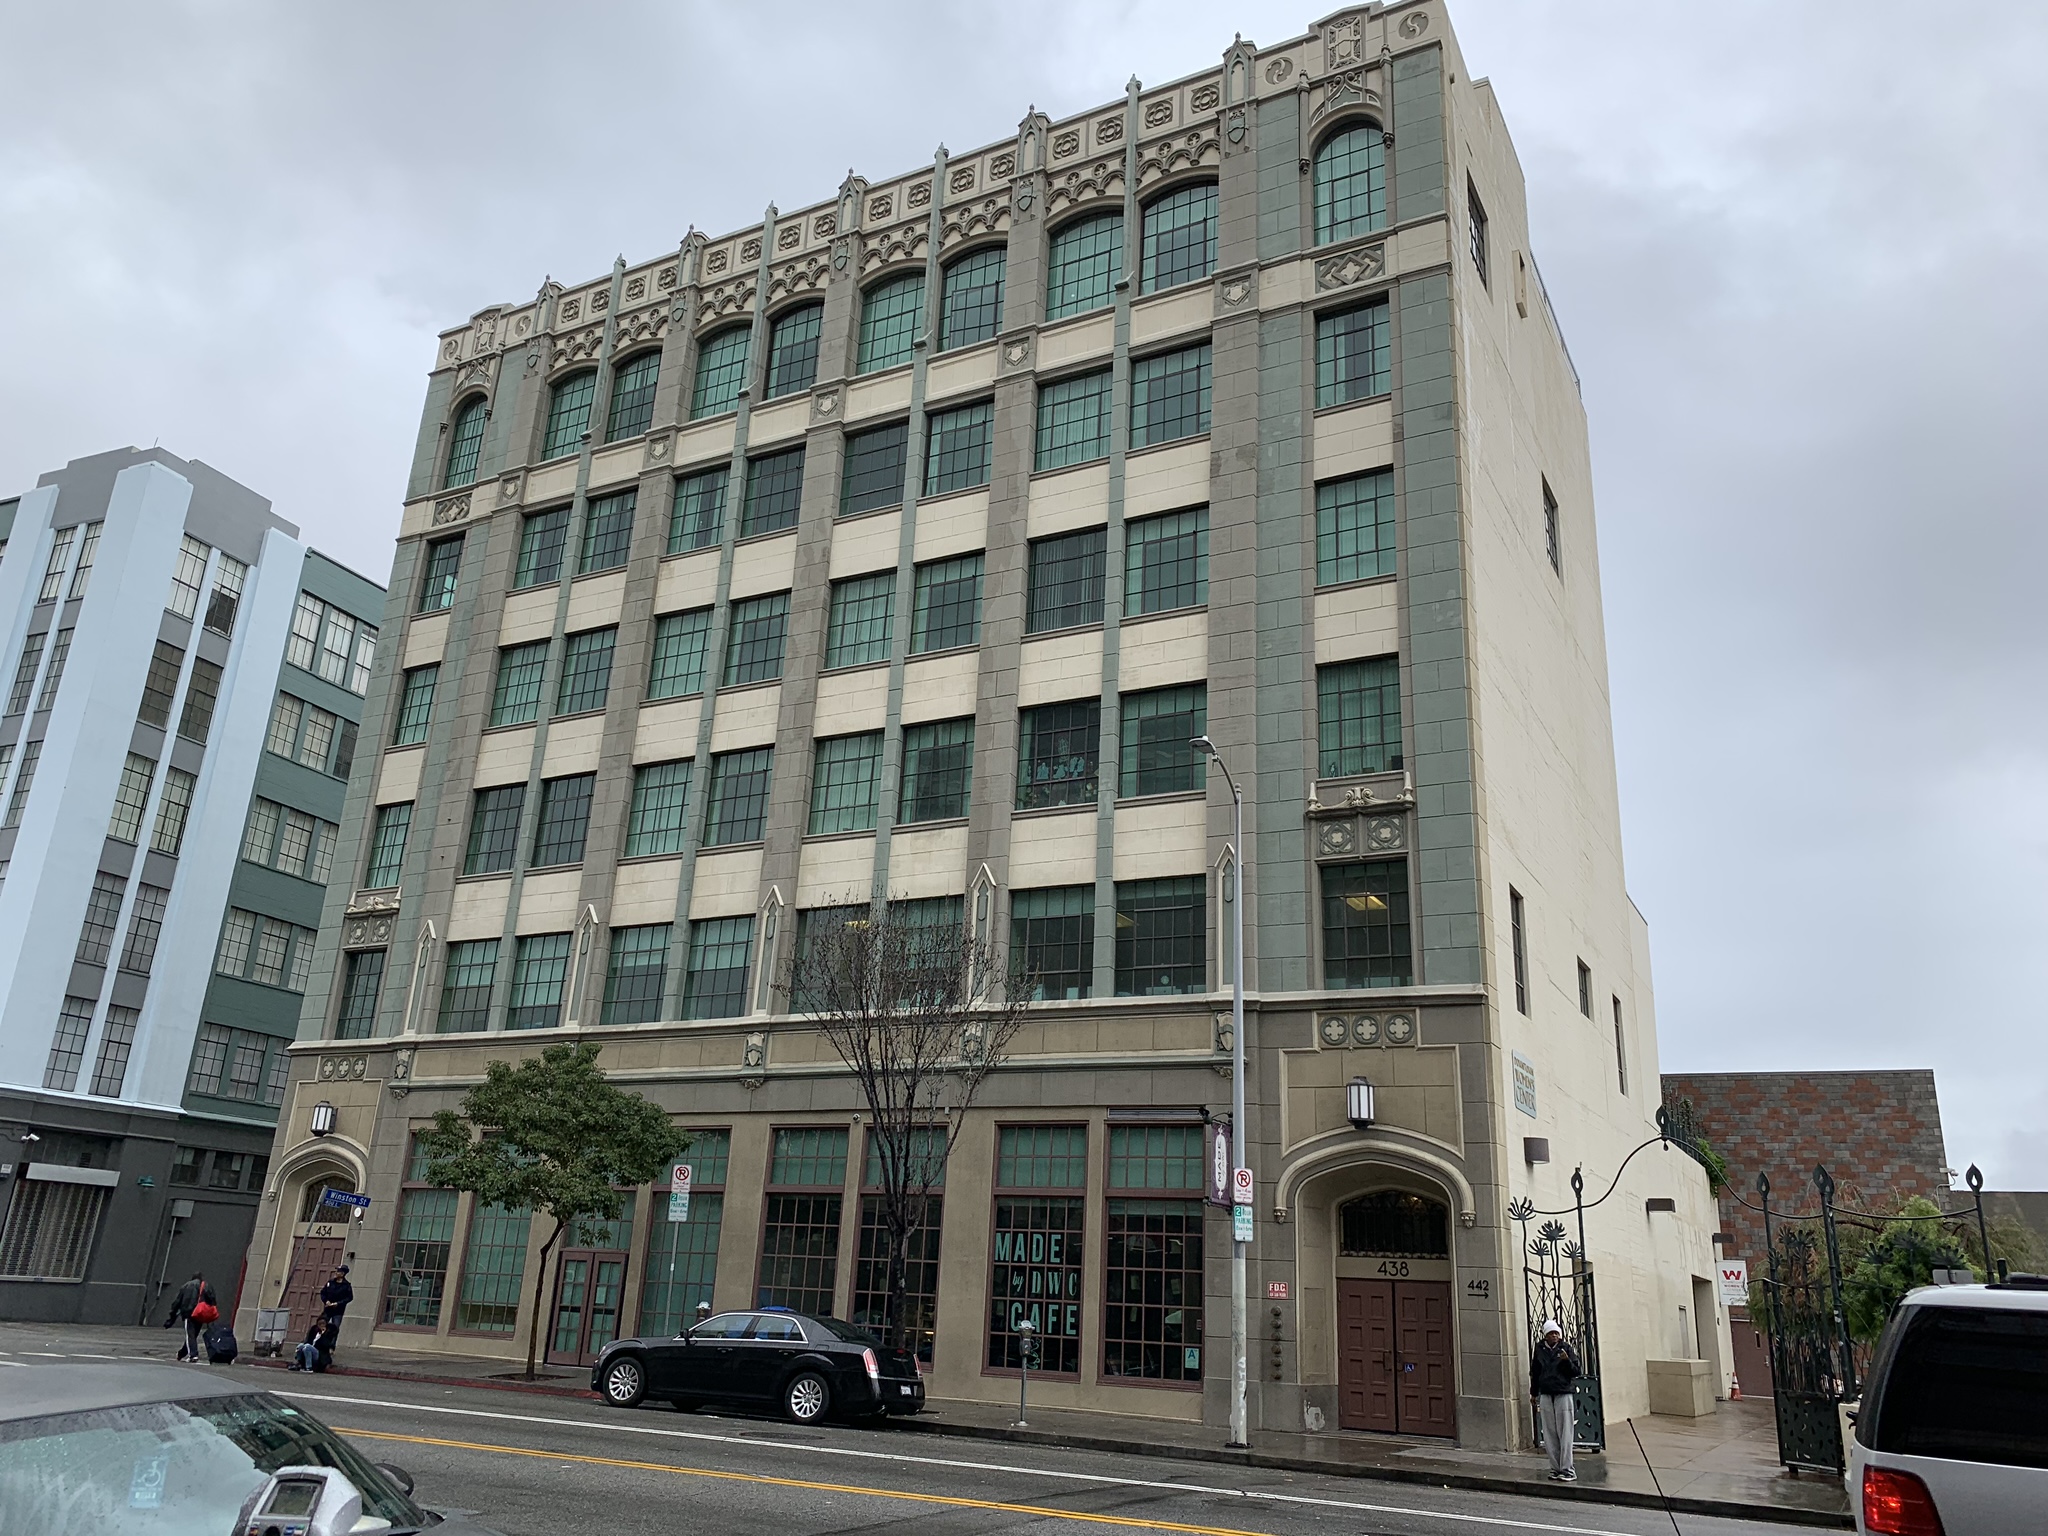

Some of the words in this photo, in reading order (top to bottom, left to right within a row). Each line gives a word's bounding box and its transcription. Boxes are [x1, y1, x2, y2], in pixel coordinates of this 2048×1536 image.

[1516, 1085, 1537, 1112] CENTER
[330, 1191, 357, 1204] Winston
[358, 1197, 367, 1206] St
[316, 1225, 333, 1237] 434
[994, 1232, 1062, 1263] MADE
[1377, 1261, 1409, 1277] 438
[1012, 1271, 1024, 1292] by
[1467, 1280, 1489, 1291] 442
[1010, 1302, 1078, 1335] CAFE
[1187, 1349, 1196, 1359] A
